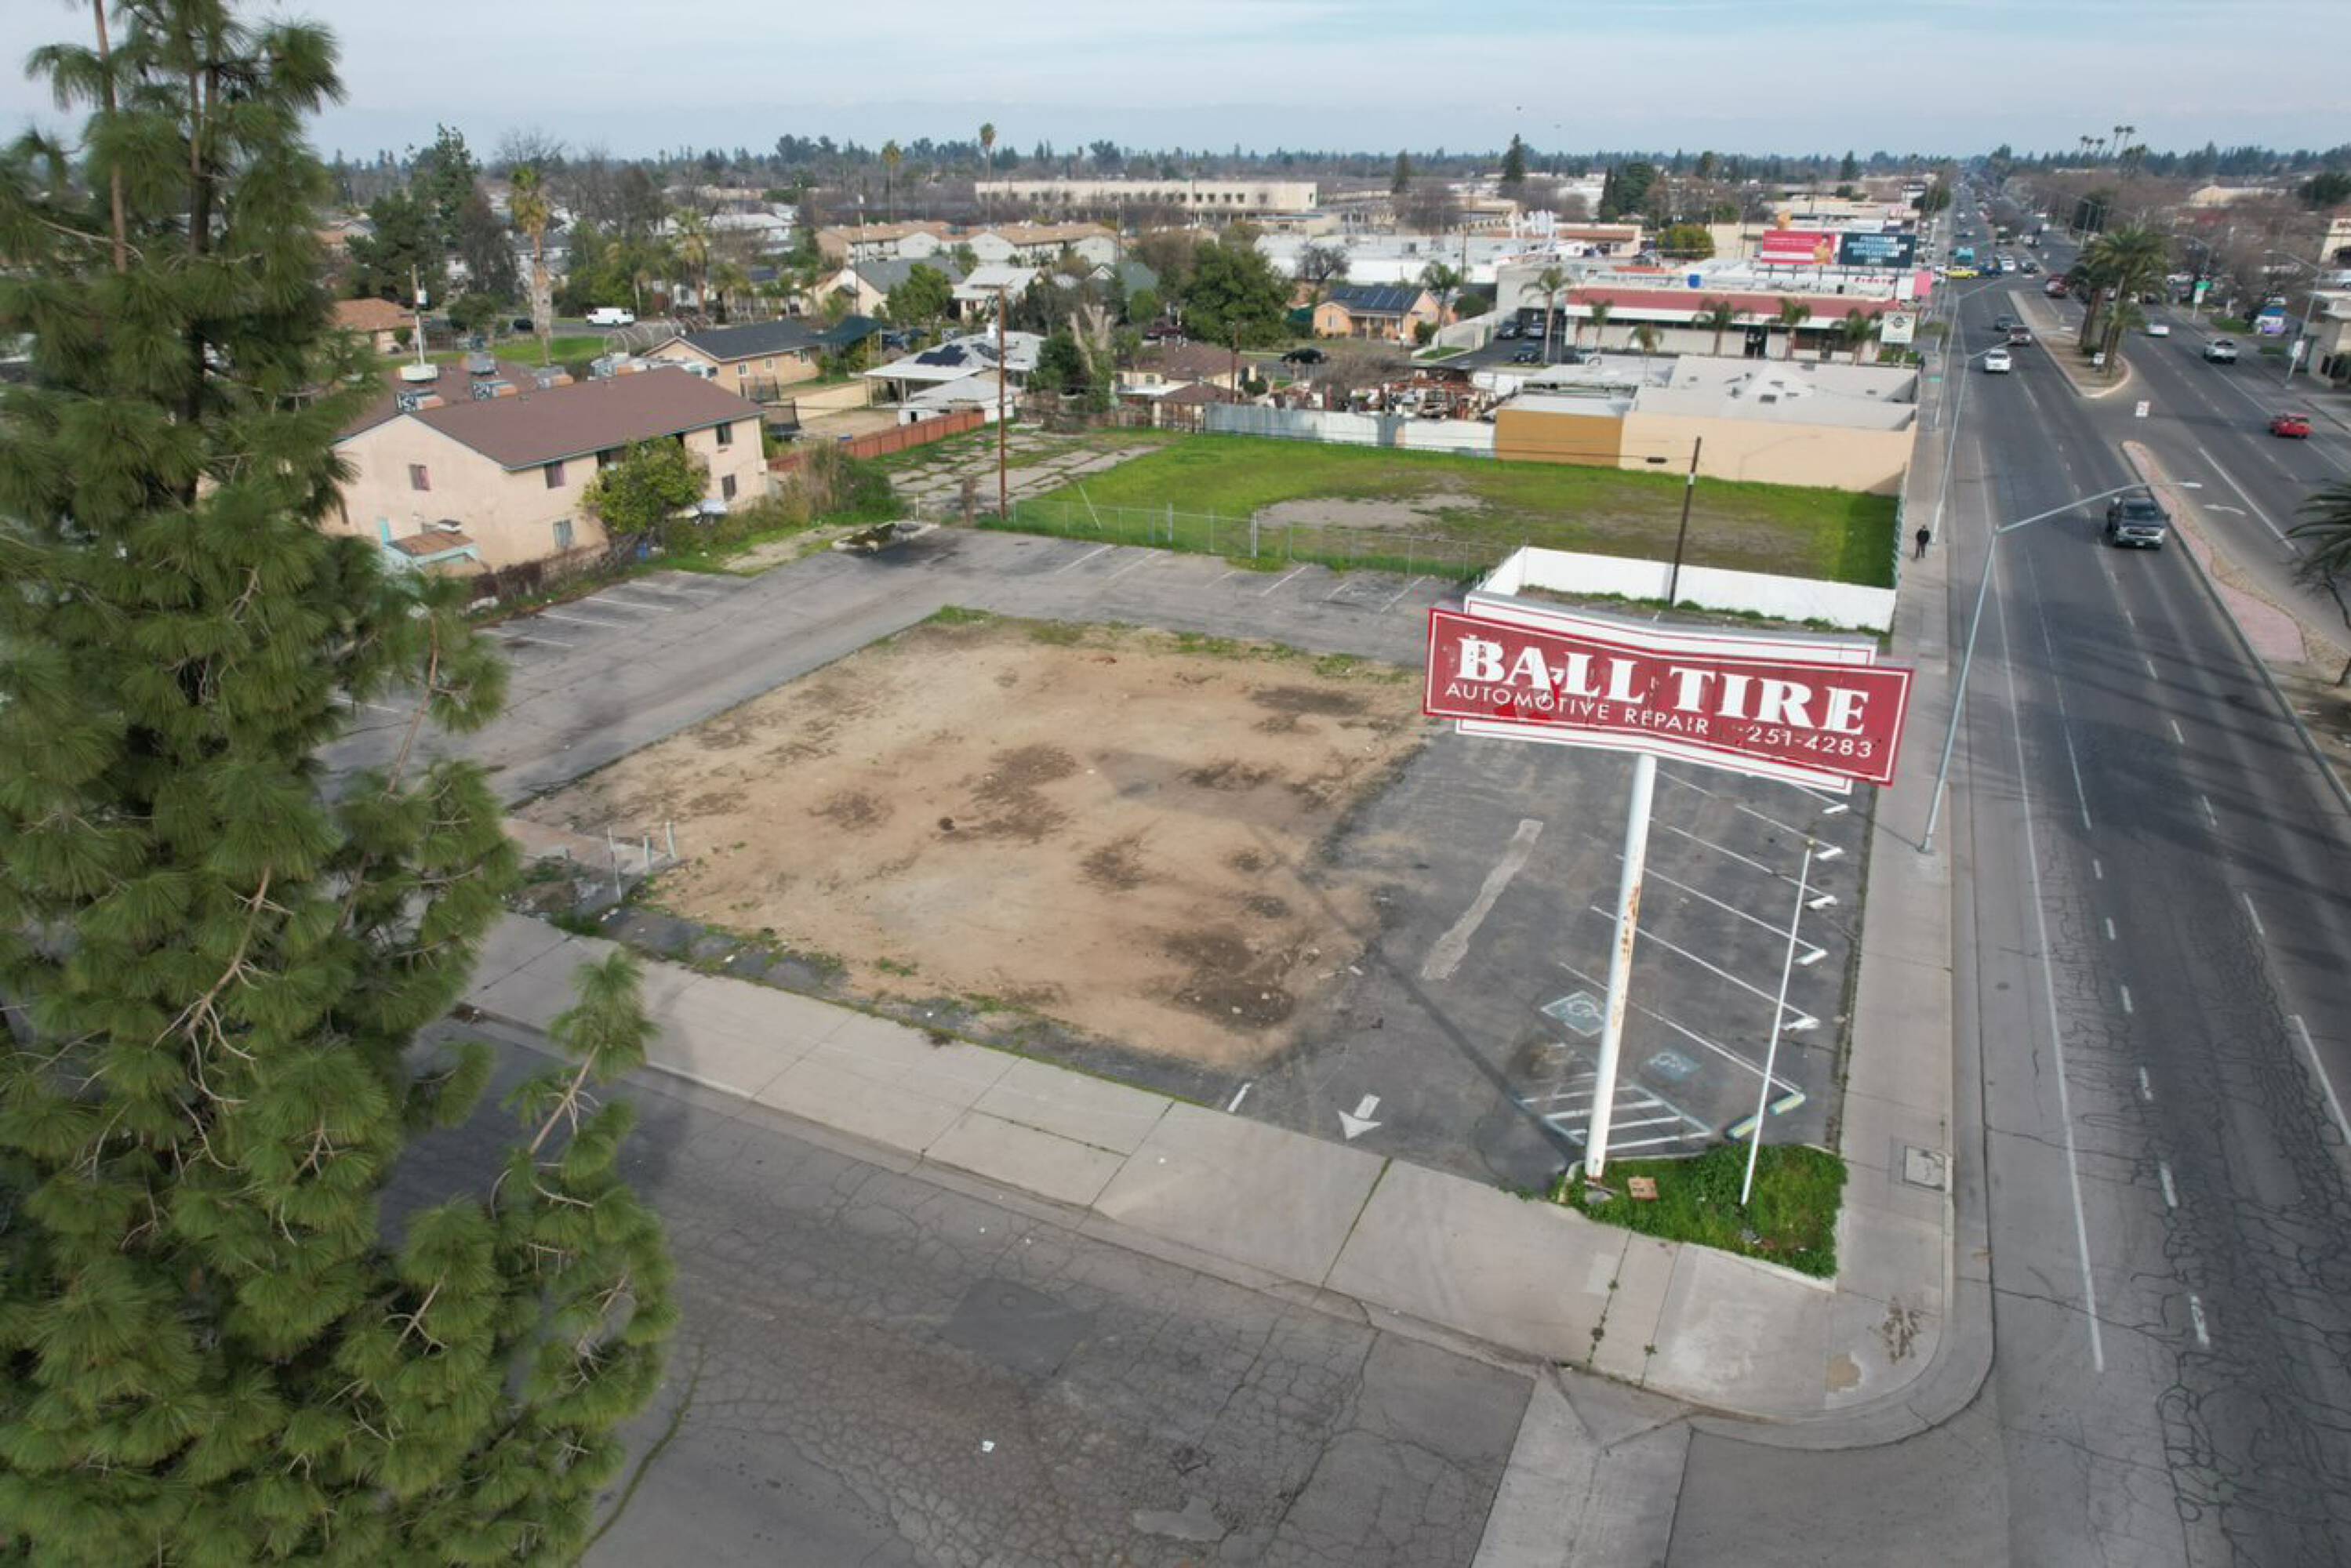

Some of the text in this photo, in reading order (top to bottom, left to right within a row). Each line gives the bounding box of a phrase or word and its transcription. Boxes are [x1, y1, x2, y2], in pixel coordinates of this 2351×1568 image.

[1444, 682, 1873, 759] AUTOMOTIVE REPAIR 251-4283
[1455, 636, 1870, 735] BALL TIRE
